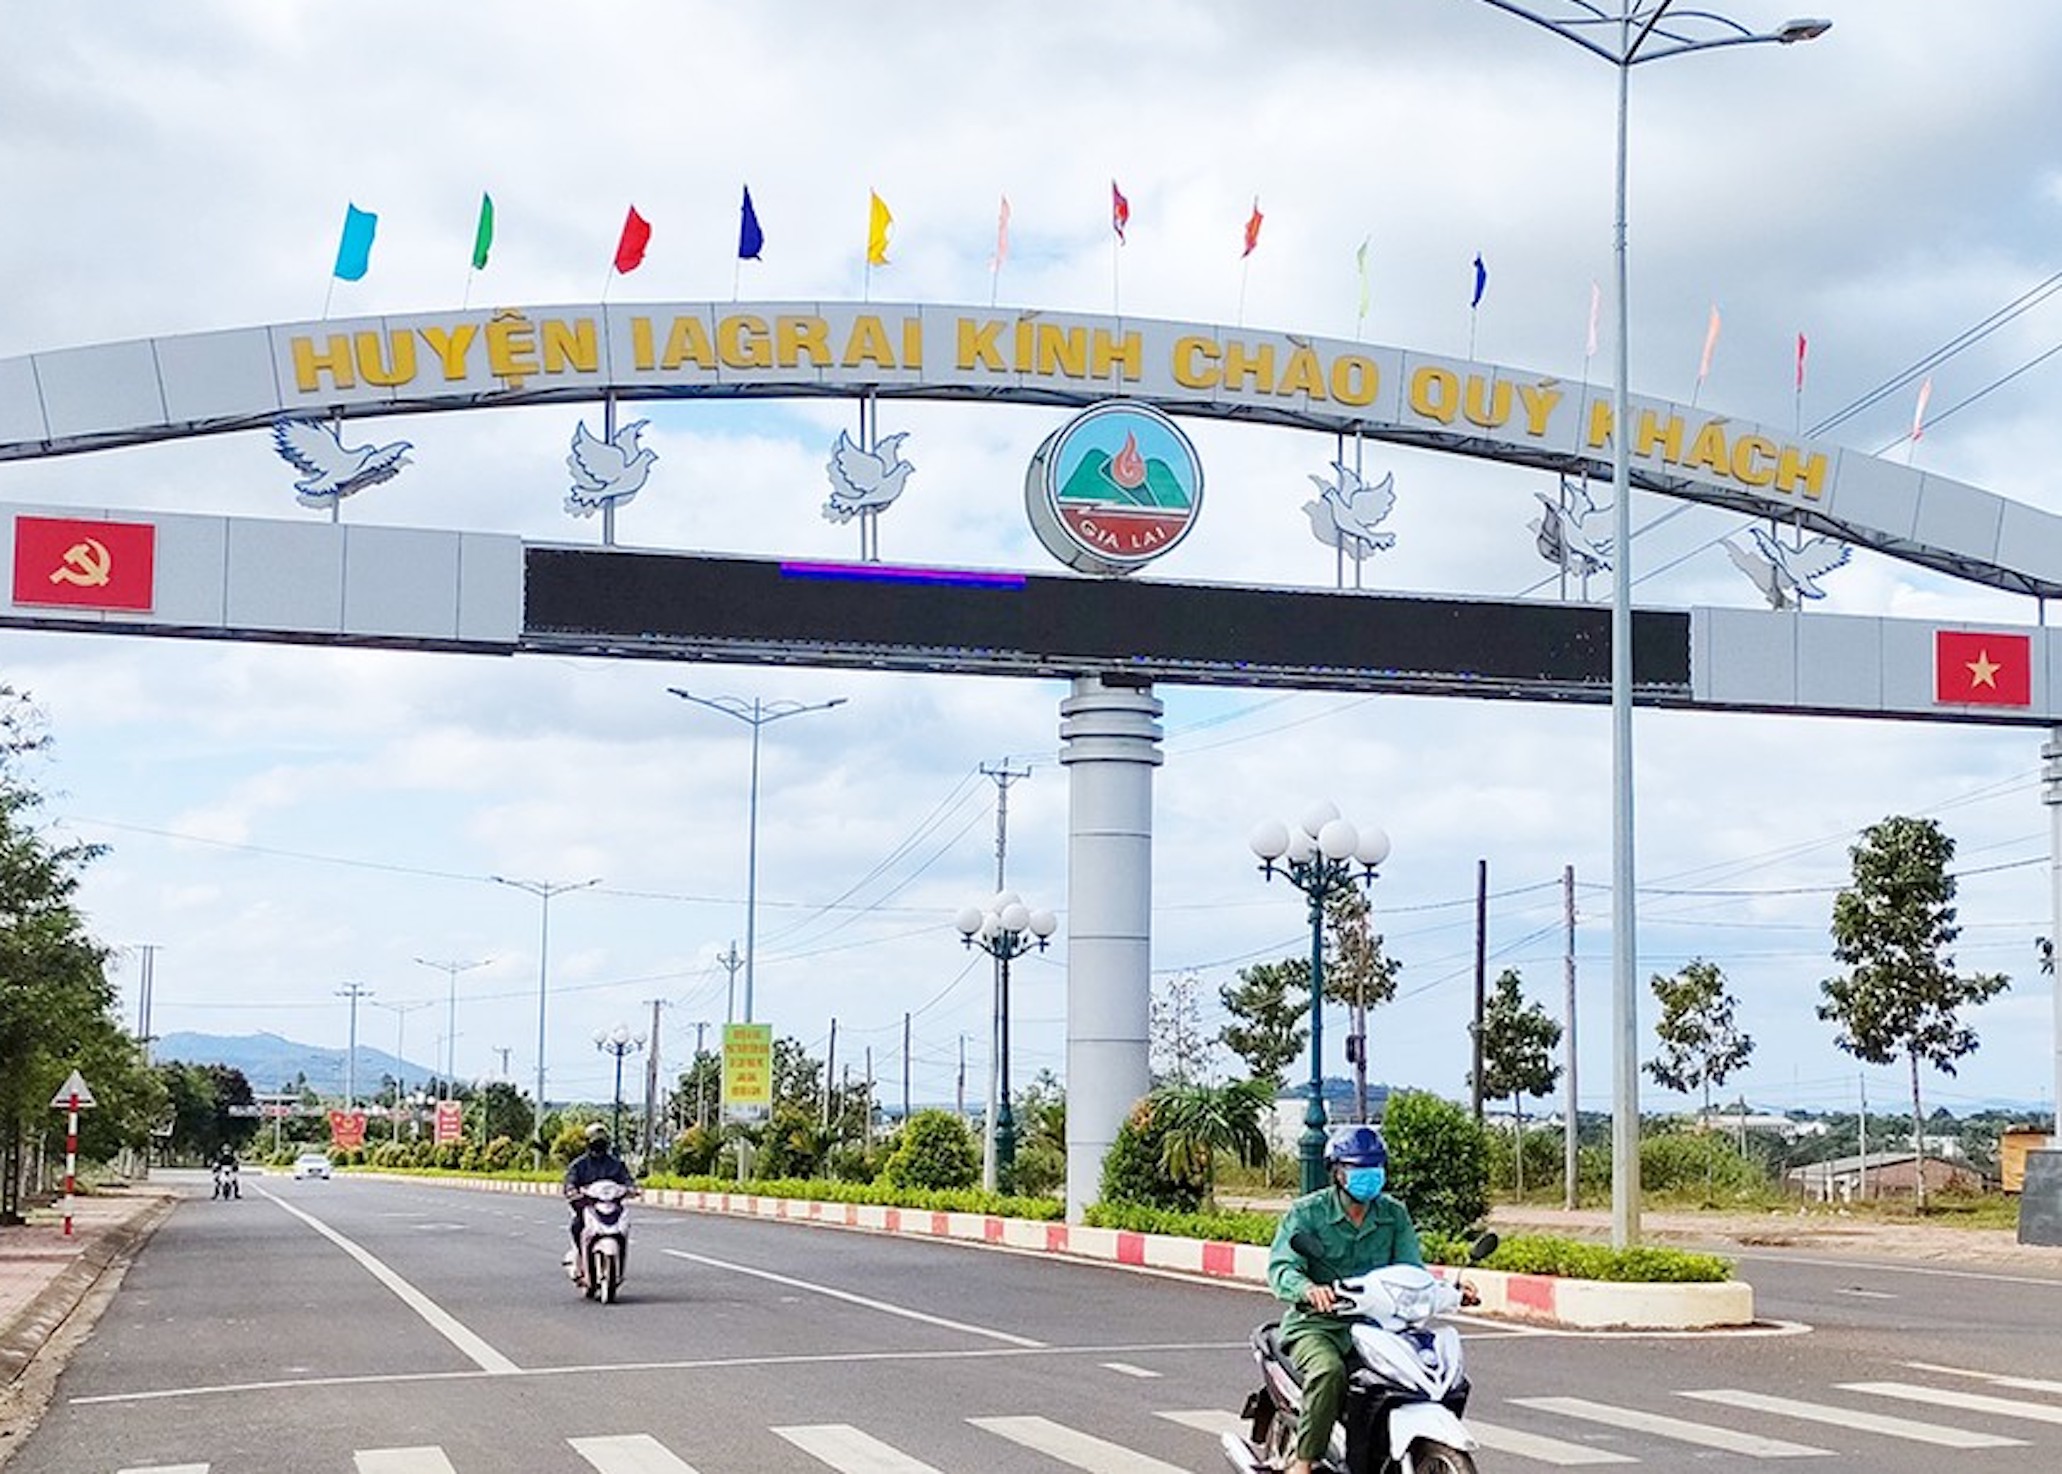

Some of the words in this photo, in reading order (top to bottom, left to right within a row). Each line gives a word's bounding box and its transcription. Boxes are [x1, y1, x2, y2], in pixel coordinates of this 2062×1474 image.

[290, 308, 600, 392] HUYỆN
[955, 310, 1143, 381] KÍNH
[1170, 334, 1380, 407] CHÀO
[1408, 366, 1563, 437] QUÝ
[1079, 519, 1120, 549] GIA
[1130, 526, 1166, 549] LAI
